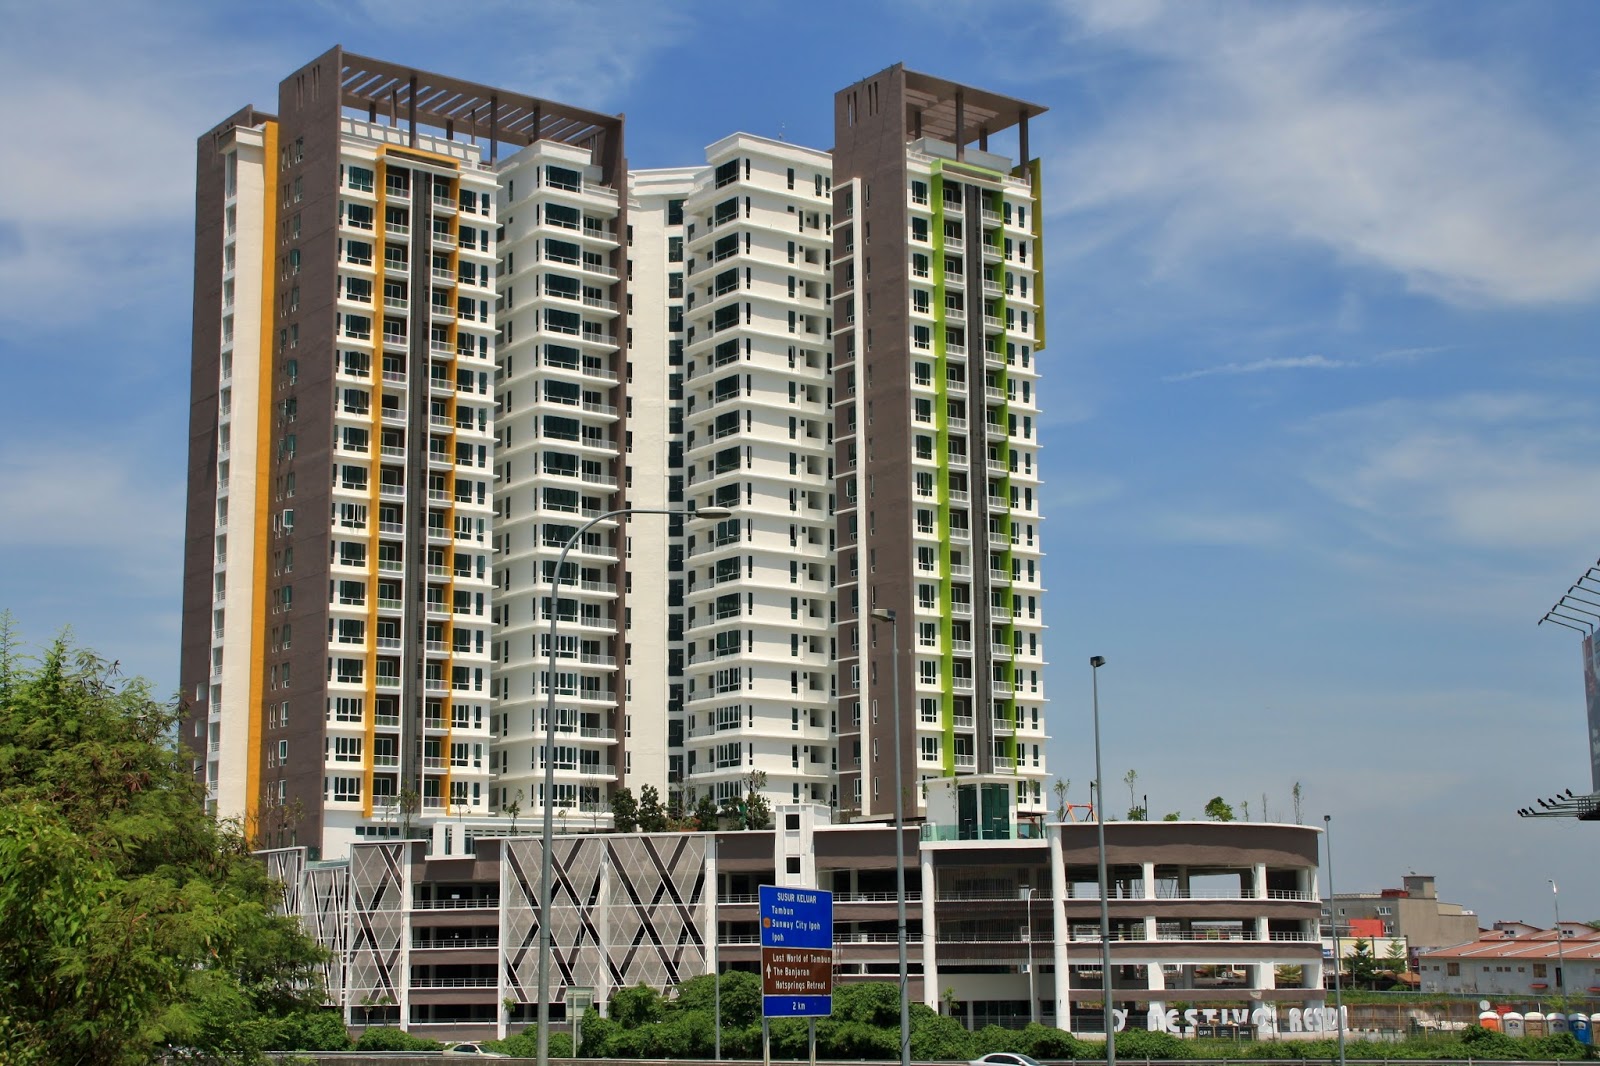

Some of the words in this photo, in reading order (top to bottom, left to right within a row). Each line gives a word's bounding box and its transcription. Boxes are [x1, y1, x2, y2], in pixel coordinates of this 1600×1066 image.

[777, 892, 795, 902] SUSUR
[796, 894, 817, 904] KELUAR
[771, 905, 794, 915] Tambun
[771, 919, 793, 930] Sunway
[795, 920, 808, 931] City
[808, 922, 821, 931] Ipoh
[772, 932, 784, 942] Ipoh
[772, 953, 785, 962] Lost
[786, 954, 802, 963] World
[803, 955, 809, 963] of
[810, 954, 831, 964] Tambun
[773, 967, 783, 976] The
[785, 967, 810, 978] Banjaran
[775, 980, 805, 991] Hotsprings
[807, 981, 826, 990] Retreat
[792, 1001, 797, 1011] 2
[798, 1001, 806, 1010] km
